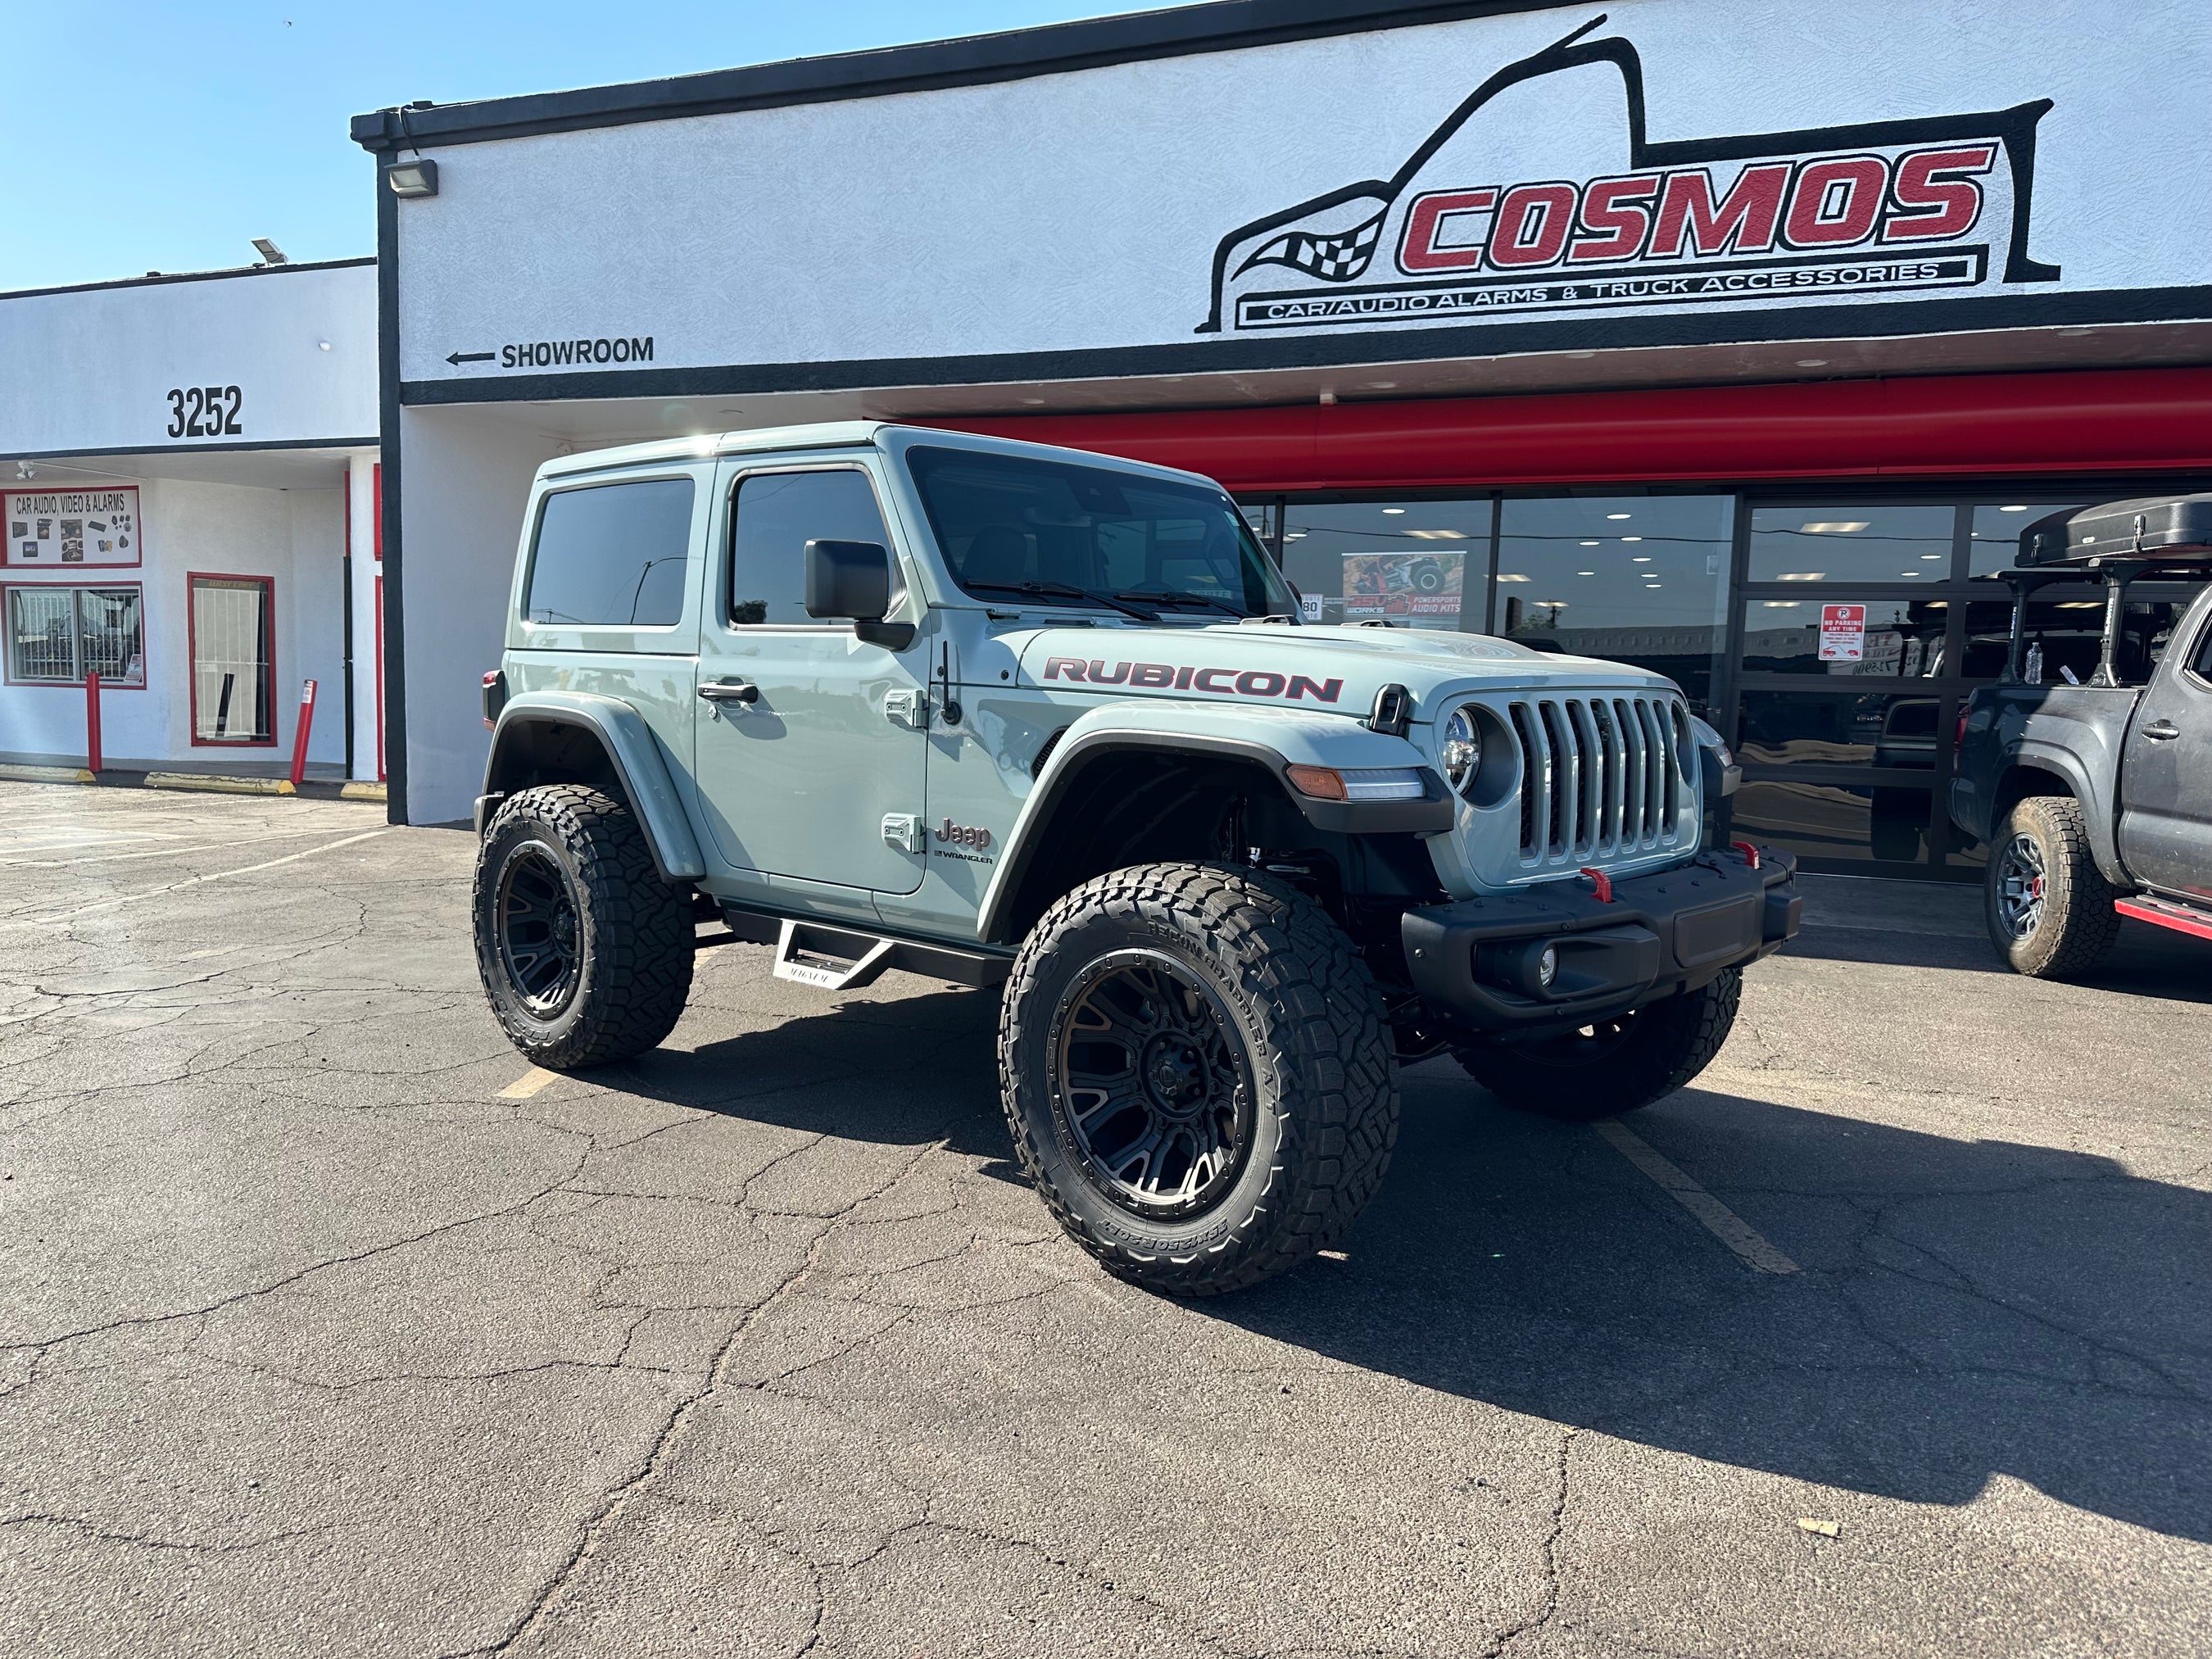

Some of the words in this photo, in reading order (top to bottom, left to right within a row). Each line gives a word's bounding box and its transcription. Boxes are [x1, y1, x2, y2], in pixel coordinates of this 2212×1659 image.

[1398, 143, 1997, 276] COSMOS
[1267, 296, 1430, 320] CAR/AUDIO
[1435, 288, 1548, 309] ALARMS
[1562, 286, 1578, 300] &
[1589, 279, 1690, 298] TRUCK
[1699, 263, 1940, 292] ACCESSORIES
[501, 337, 654, 368] SHOWROOM
[166, 385, 243, 438] 3252
[16, 496, 32, 514] CAR
[34, 495, 60, 516] AUDIO,
[61, 495, 84, 514] VIDEO
[86, 495, 92, 512] &
[93, 493, 125, 512] ALARMS
[1303, 602, 1317, 612] 80
[1412, 604, 1438, 613] AUDIO
[1440, 603, 1461, 613] KITS
[1413, 596, 1462, 604] POWERSPORTS
[1042, 656, 1344, 704] RUBICON
[934, 817, 991, 851] Jeep
[942, 850, 994, 864] WRANGLER
